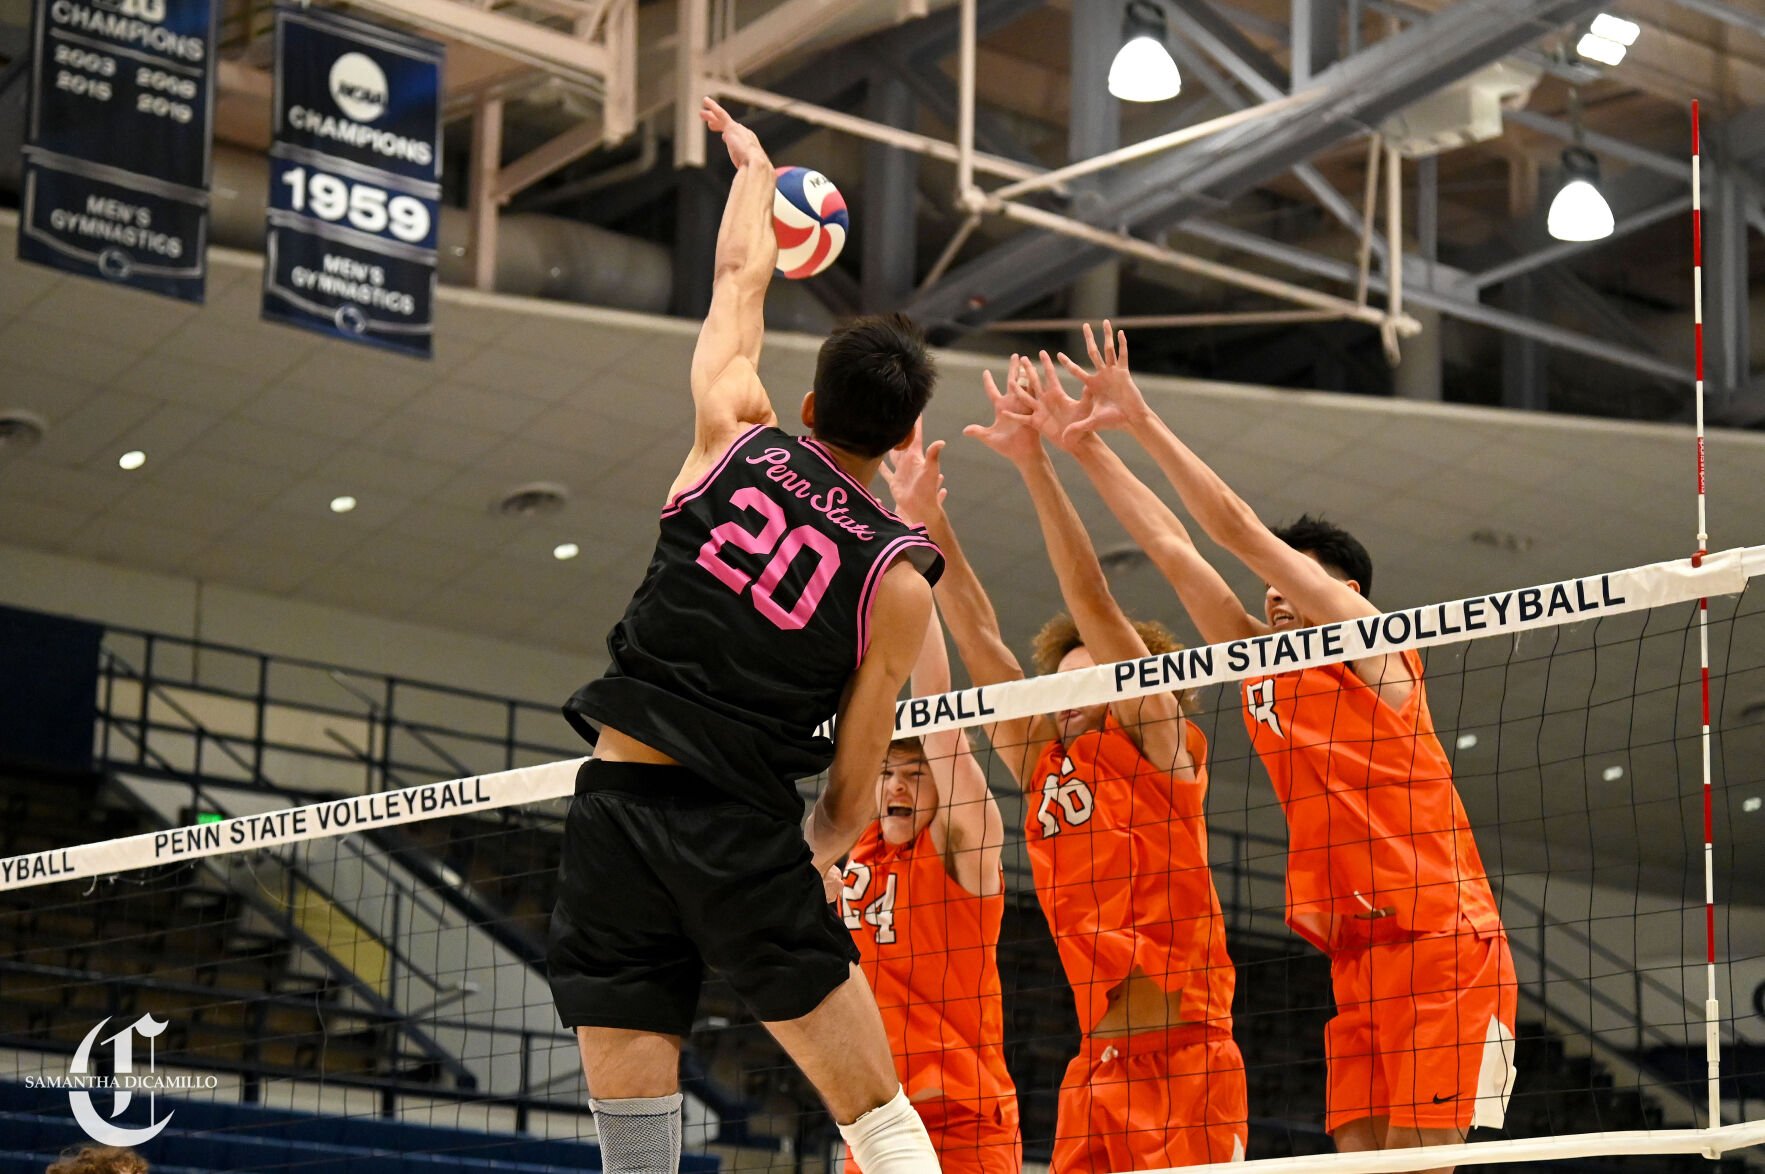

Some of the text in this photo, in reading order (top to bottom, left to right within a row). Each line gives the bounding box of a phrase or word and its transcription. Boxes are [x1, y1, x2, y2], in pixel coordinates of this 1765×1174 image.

[51, 0, 204, 61] CHAMPIONS
[288, 104, 433, 166] CHAMPIONS
[50, 208, 182, 258] GYMNASTICS
[281, 166, 431, 243] 1959
[291, 265, 415, 316] GYMNASTICS
[745, 447, 877, 541] Penn State
[695, 486, 841, 631] 20
[1115, 574, 1626, 692] PENN STATE VOLLEYBALL
[154, 778, 491, 858] PENN STATE VOLLEYBALL
[842, 860, 898, 944] 24
